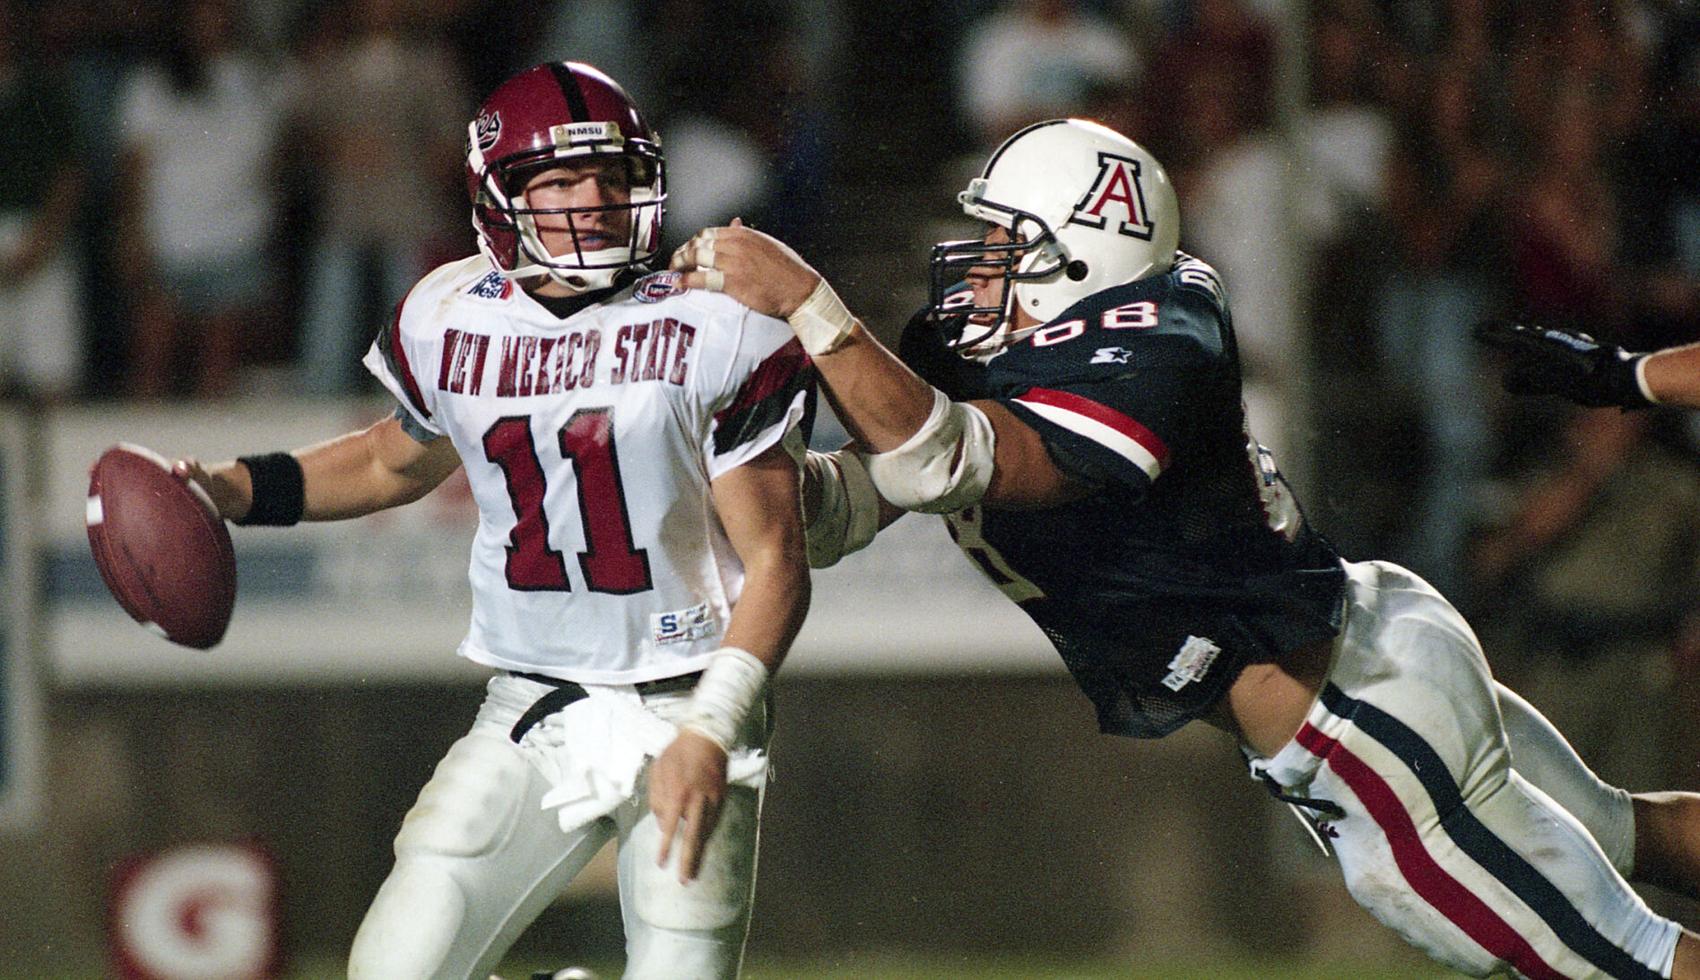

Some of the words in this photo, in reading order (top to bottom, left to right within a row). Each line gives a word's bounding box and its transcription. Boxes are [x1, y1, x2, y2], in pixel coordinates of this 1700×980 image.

[568, 127, 602, 136] NMSU
[1068, 151, 1155, 242] A
[496, 329, 601, 398] MEXICO
[610, 317, 697, 387] STATE
[481, 405, 654, 595] 11
[660, 613, 678, 634] S
